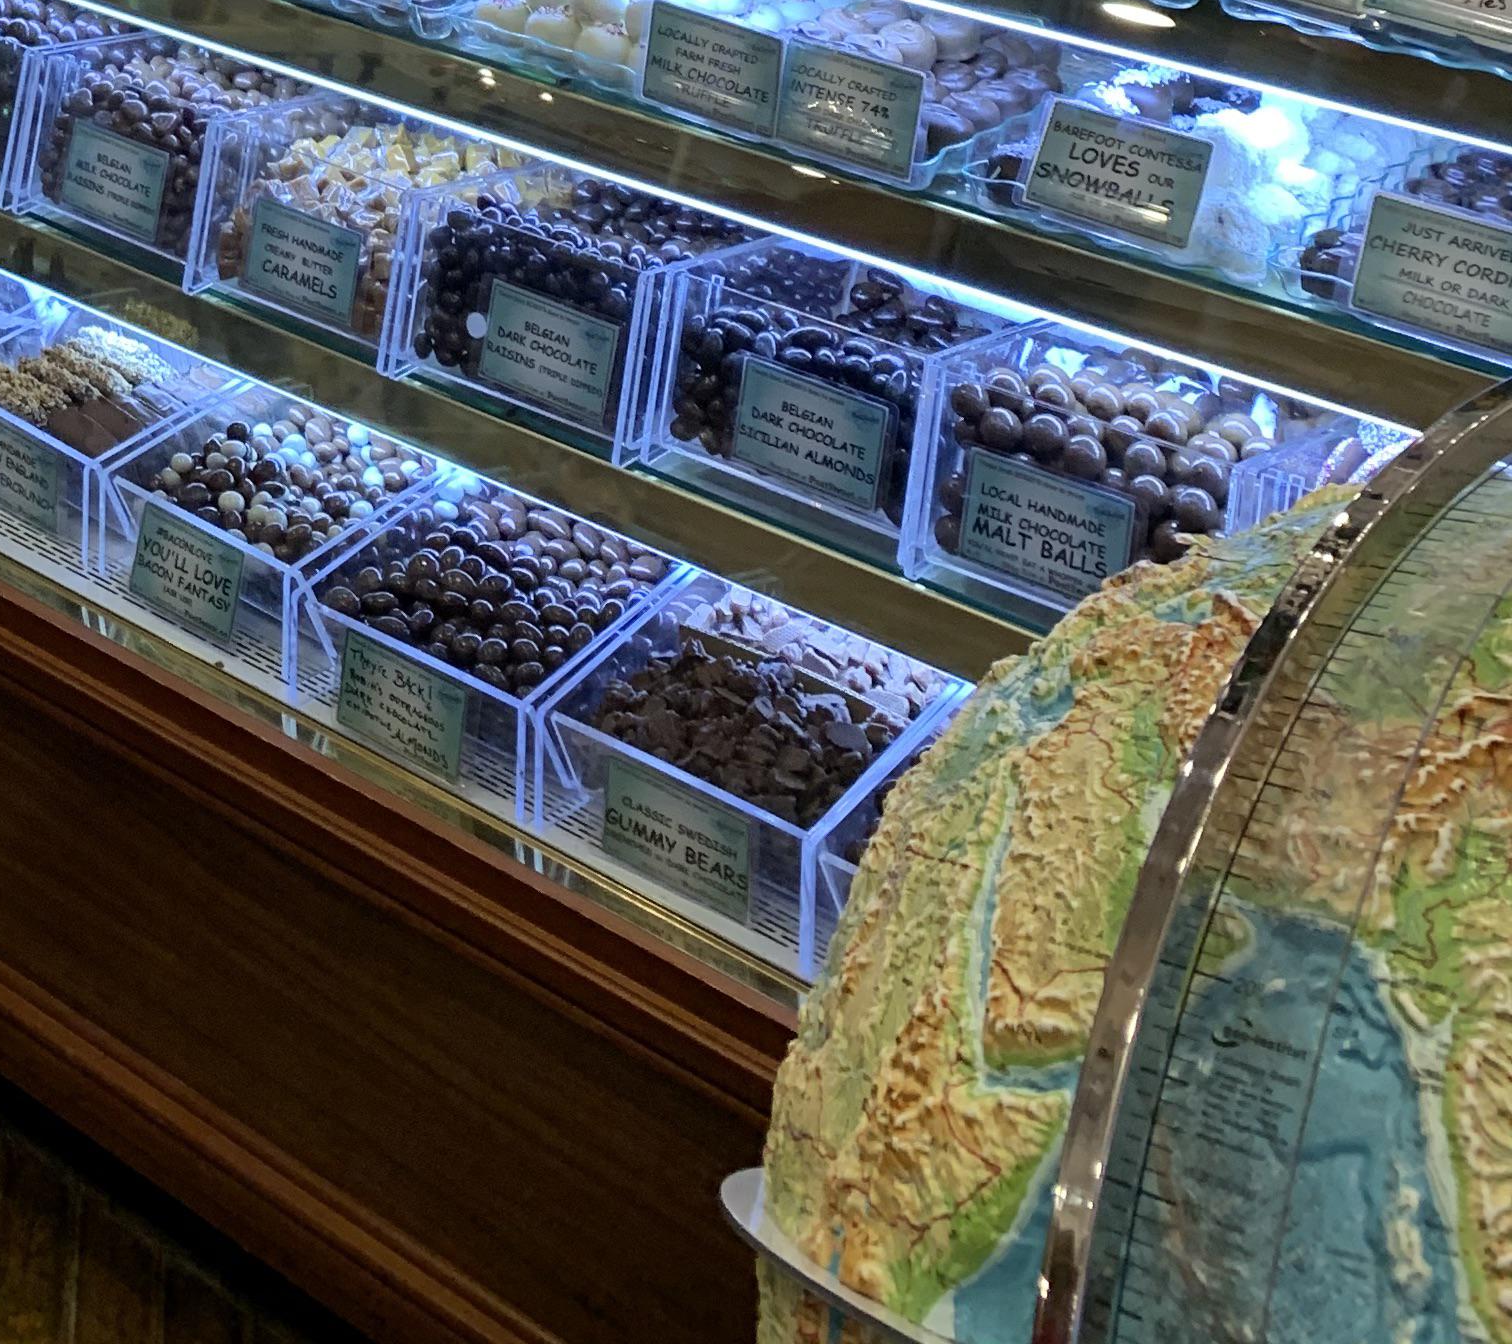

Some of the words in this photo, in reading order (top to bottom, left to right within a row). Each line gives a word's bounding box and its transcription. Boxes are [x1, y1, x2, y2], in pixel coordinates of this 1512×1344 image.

[657, 23, 709, 49] LOCALLY
[711, 40, 760, 65] CRAFTED
[675, 46, 706, 64] FARM
[707, 56, 742, 74] FRESH
[651, 55, 684, 78] MILK
[688, 69, 769, 104] CHOCOLATE
[790, 63, 845, 87] LOCALLY
[847, 78, 898, 102] CRAFTED
[791, 78, 858, 108] INTENSE
[96, 152, 133, 176] BELGIAN
[1052, 119, 1127, 151] BAREFOOT
[1129, 142, 1204, 176] CONTESSA
[1068, 143, 1141, 179] LOVES
[1148, 172, 1175, 190] OUR
[99, 168, 152, 199] CHOCOLATE
[1035, 161, 1177, 213] SNOWBALLS
[261, 222, 289, 243] FRESH
[291, 234, 345, 264] HANDMADE
[1369, 234, 1449, 267] CHERRY
[1401, 221, 1445, 243] JUST
[261, 259, 338, 300] CARAMELS
[301, 256, 334, 277] BUTTER
[1399, 268, 1435, 287] MILK
[1441, 280, 1463, 296] OR
[1467, 287, 1510, 310] DARK
[1402, 290, 1492, 328] CHOCOLATE
[498, 325, 527, 348] DARK
[529, 339, 599, 375] CHOCOLATE
[524, 320, 570, 348] BELGIAN
[487, 341, 537, 370] RAISINS
[751, 405, 784, 431] DARK
[788, 418, 866, 461] CHOCOLATE
[781, 399, 834, 431] BELGIAN
[5, 457, 49, 490] ENGLAND
[739, 424, 800, 458] SICILIAN
[804, 449, 876, 487] ALMONDS
[977, 502, 1013, 526] MILK
[1019, 517, 1107, 559] CHOCOLATE
[981, 482, 1022, 508] LOCAL
[1027, 498, 1107, 538] HANDMADE
[143, 535, 189, 574] YOU'LL
[194, 564, 232, 596] LOVE
[972, 516, 1033, 551] MALT
[1040, 539, 1108, 579] BALLS
[137, 553, 174, 583] BACON
[177, 576, 232, 613] FANTASY
[605, 807, 677, 854] GUMMY
[685, 846, 749, 890] BEARS
[622, 795, 674, 829] CLASSIC
[677, 823, 738, 860] SWEDISH
